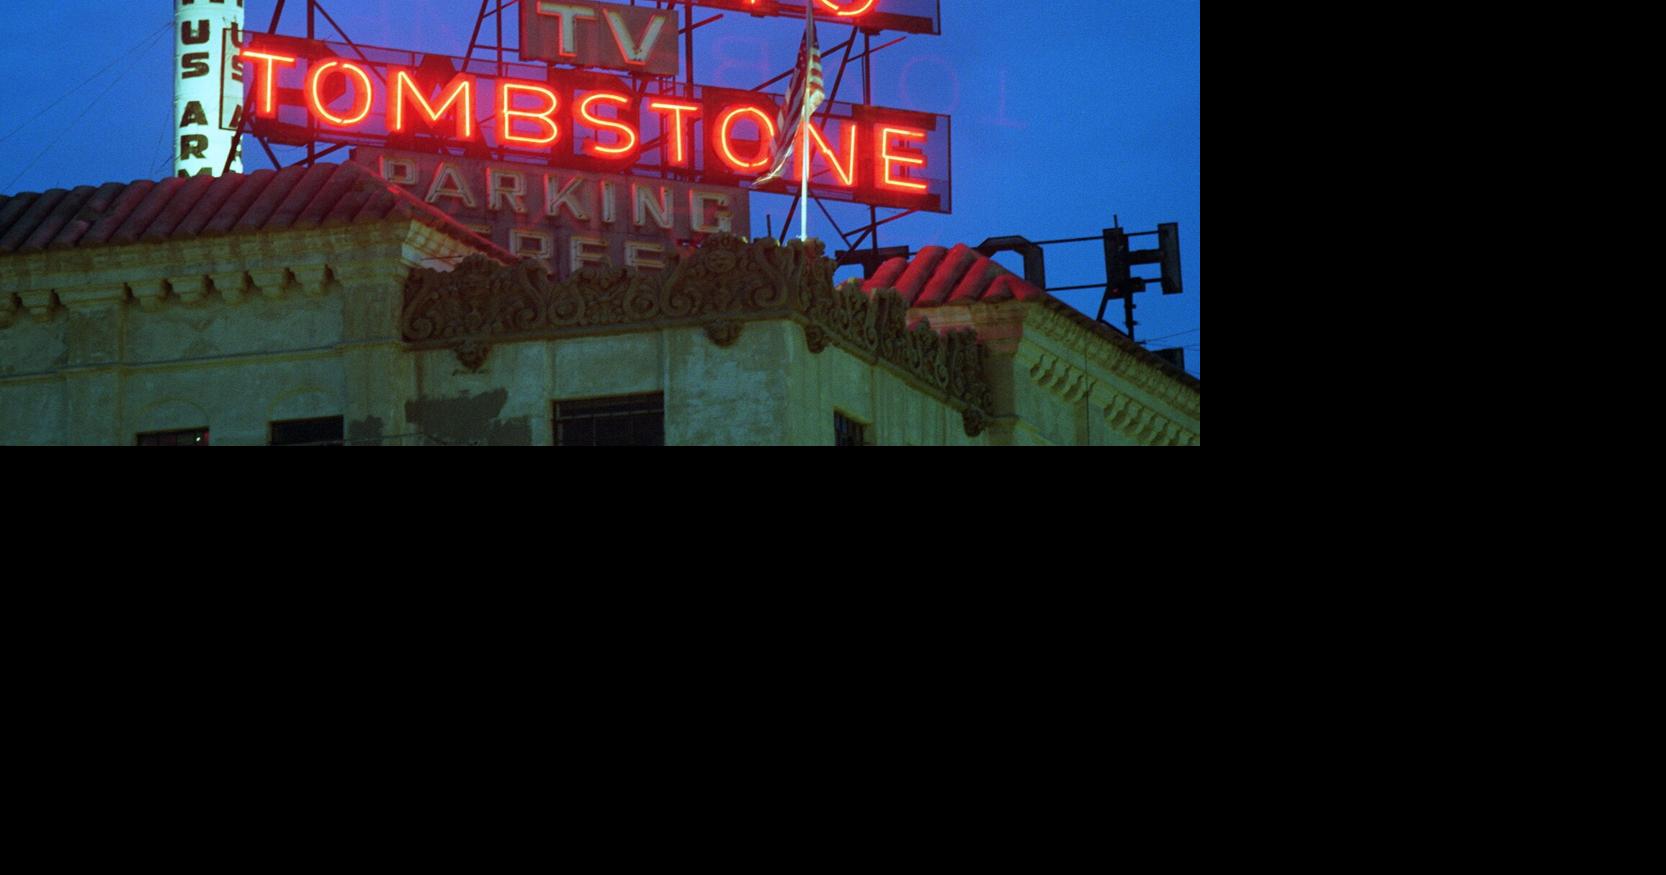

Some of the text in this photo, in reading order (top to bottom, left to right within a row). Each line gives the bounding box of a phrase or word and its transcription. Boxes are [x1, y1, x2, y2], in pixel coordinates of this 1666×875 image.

[536, 0, 667, 66] TV
[239, 47, 930, 195] TOMBSTONE
[378, 154, 734, 235] PARKING
